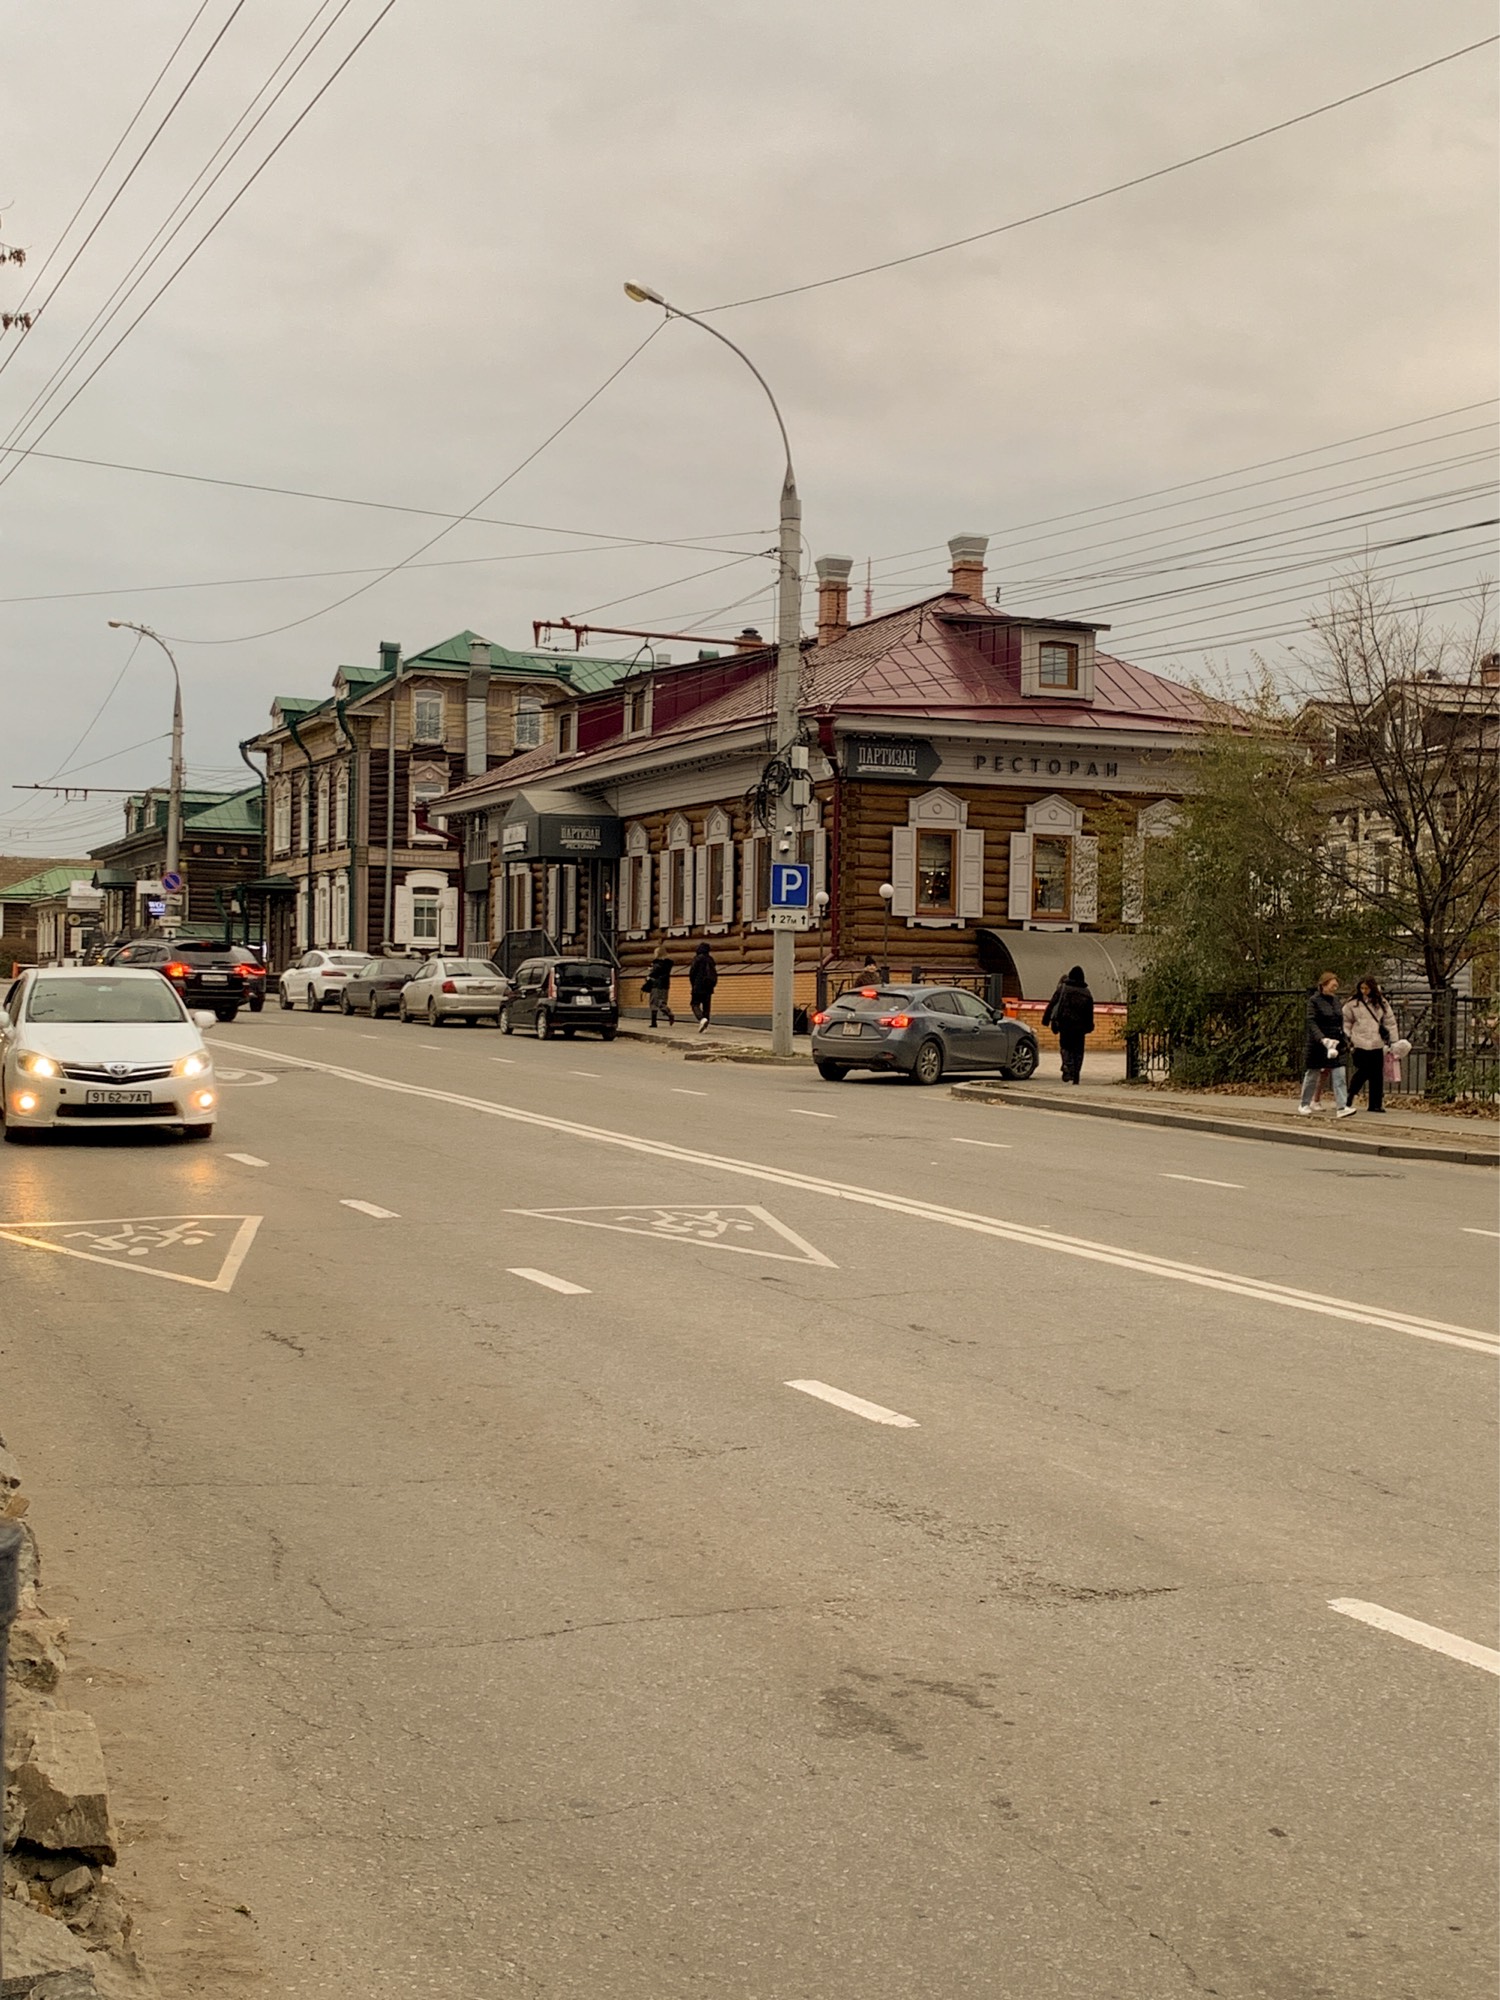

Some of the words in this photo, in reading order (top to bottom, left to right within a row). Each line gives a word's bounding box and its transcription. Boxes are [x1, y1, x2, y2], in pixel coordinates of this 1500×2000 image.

[858, 747, 917, 767] ПАРТИЗАН
[975, 754, 1118, 777] РЕСТОРАН
[781, 868, 803, 902] P
